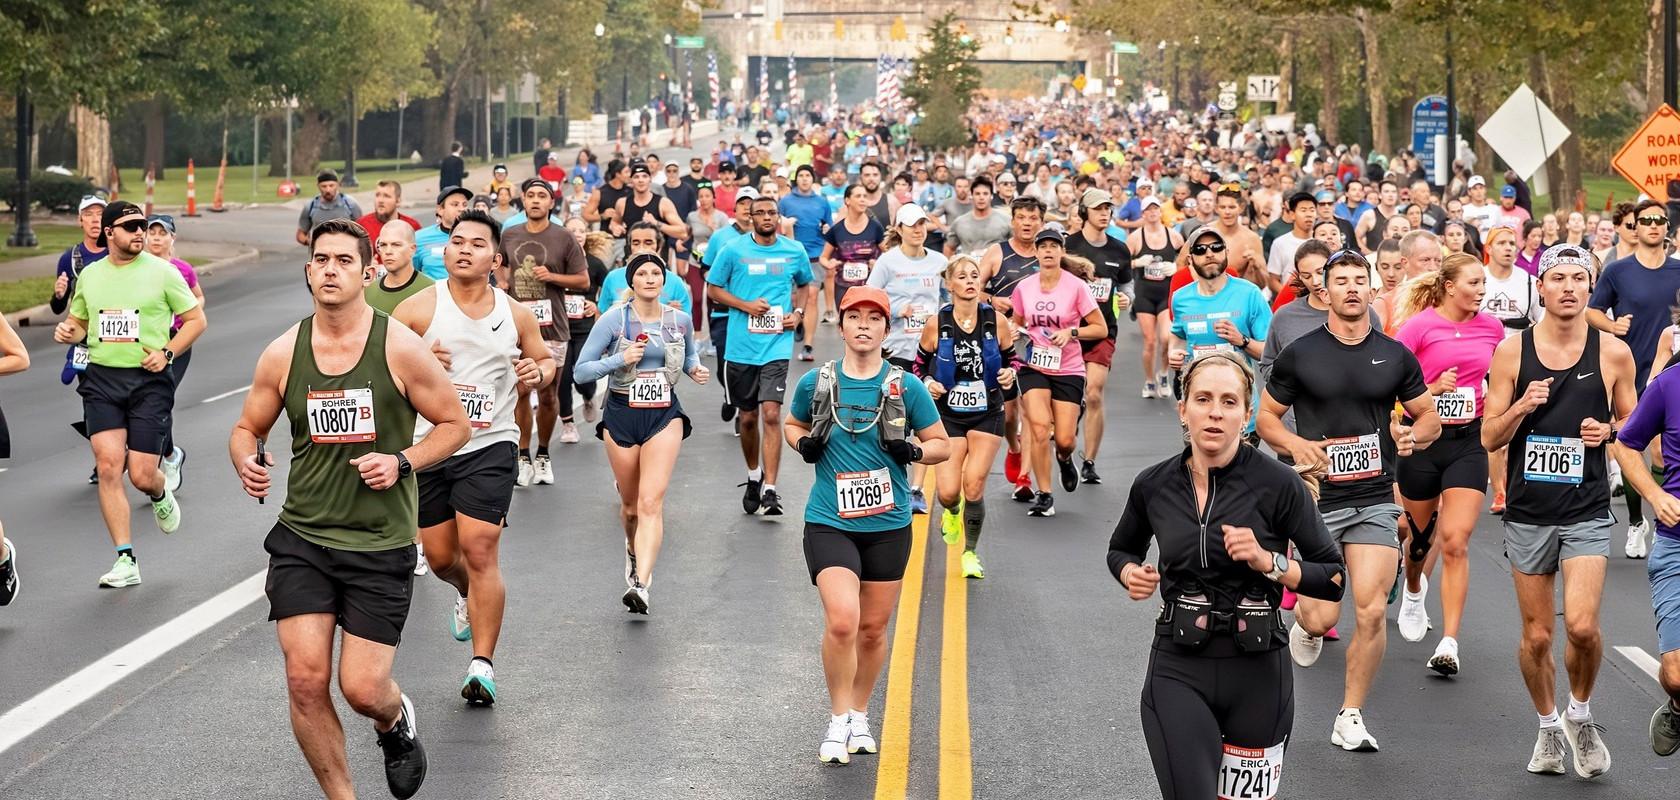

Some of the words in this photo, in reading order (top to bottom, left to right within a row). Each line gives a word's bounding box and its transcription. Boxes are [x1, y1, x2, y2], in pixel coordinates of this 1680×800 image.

[1220, 96, 1234, 106] 62
[1647, 134, 1680, 147] ROA
[1648, 154, 1680, 167] WOR
[1089, 285, 1105, 298] 213
[1035, 301, 1056, 312] GO
[101, 320, 129, 336] 14124
[130, 321, 138, 329] B
[750, 315, 776, 329] 13085
[1031, 314, 1061, 329] JEN
[75, 352, 90, 364] 22
[459, 391, 489, 400] AKOKEY
[632, 384, 663, 401] 14264
[663, 383, 670, 393] B
[949, 390, 977, 407] 2785
[977, 391, 985, 400] A
[321, 398, 357, 407] BOHRER
[483, 401, 493, 412] C
[1465, 400, 1474, 413] B
[311, 407, 357, 433] 10807
[359, 406, 372, 419] B
[1331, 442, 1370, 453] JONATHAN
[1533, 444, 1577, 453] KILPATRICK
[1330, 449, 1370, 474] 10238
[1370, 448, 1379, 460] B
[1527, 450, 1570, 474] 2106
[1571, 453, 1582, 466] B
[851, 477, 879, 487] NICOLE
[840, 484, 882, 509] 11269
[882, 481, 891, 494] B
[1240, 759, 1270, 769] ERICA
[1221, 765, 1271, 799] 17241
[1273, 764, 1281, 780] B
